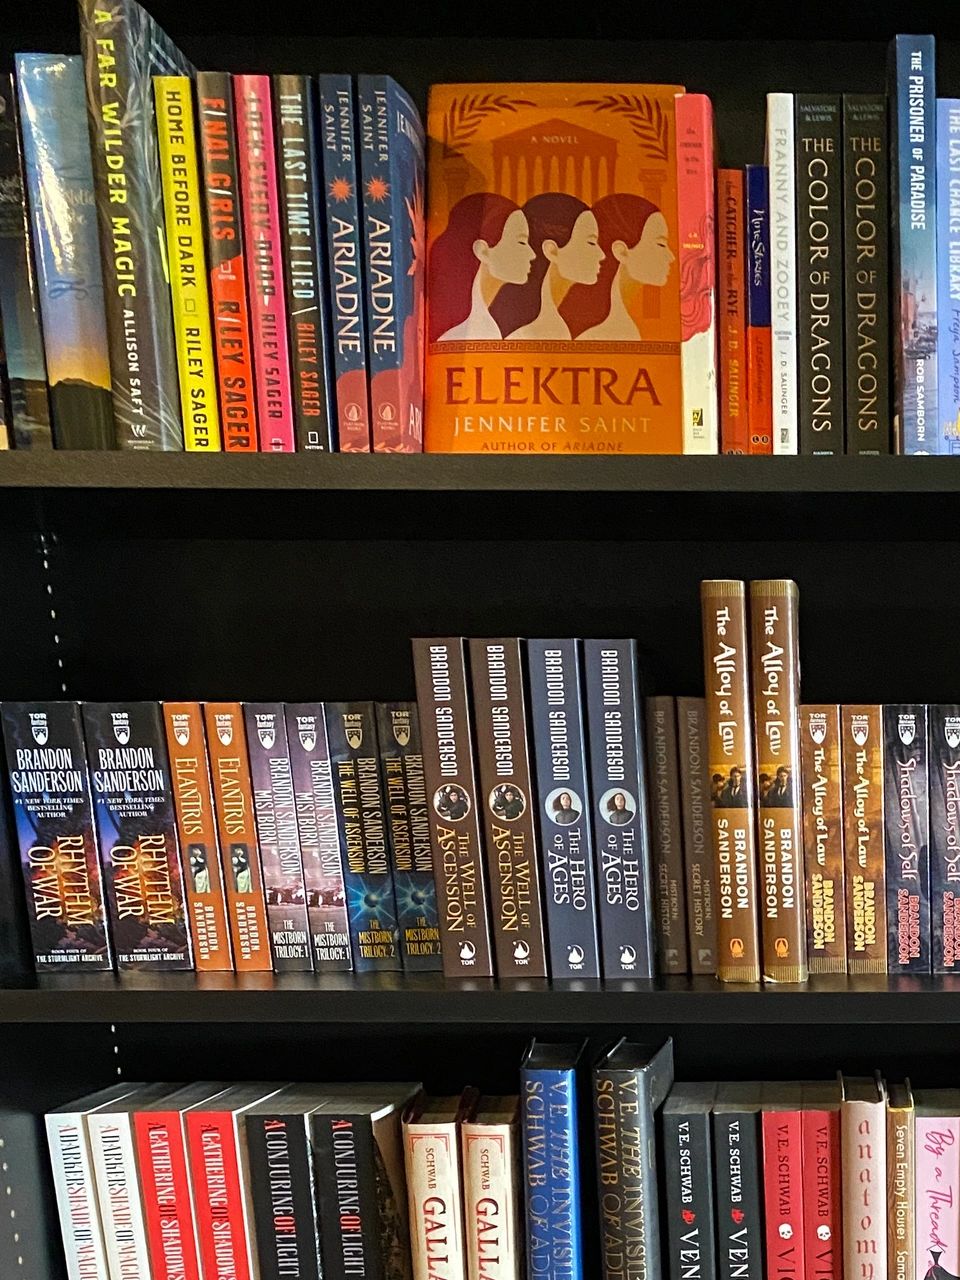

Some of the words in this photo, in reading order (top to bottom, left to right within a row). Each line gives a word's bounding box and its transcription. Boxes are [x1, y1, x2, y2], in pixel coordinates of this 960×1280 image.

[94, 9, 112, 24] A
[96, 39, 118, 88] FAR
[911, 51, 922, 70] THE
[166, 91, 184, 144] HOME
[325, 105, 336, 152] SAINT
[336, 91, 351, 162] JENNIFER
[909, 75, 925, 142] PRISONER
[101, 103, 127, 205] WILDER
[531, 135, 538, 144] A
[543, 136, 578, 144] NOVEL
[802, 138, 834, 153] THE
[912, 148, 922, 161] OF
[172, 154, 190, 226] BEFORE
[808, 158, 828, 264] COLOR
[911, 166, 926, 230] PARADISE
[111, 217, 136, 297] MAGIC
[177, 235, 195, 287] DARK
[810, 271, 831, 285] OF
[332, 216, 361, 353] ARIADNE
[122, 309, 140, 373] ALLISON
[185, 328, 203, 380] RILEY
[810, 293, 831, 431] DRAGONS
[446, 367, 663, 406] ELEKTRA
[915, 359, 924, 382] ROB
[129, 378, 144, 416] SAFT
[191, 389, 209, 447] SAGER
[916, 385, 925, 441] SAMBORN
[454, 417, 567, 435] JENNIFER
[580, 418, 650, 432] SAINT
[481, 441, 538, 451] AUTHOR
[542, 441, 557, 451] OF
[563, 441, 623, 451] ARIADNE
[716, 606, 731, 636] The
[716, 642, 736, 696] Alloy
[720, 700, 733, 715] of
[16, 749, 72, 769] BRANDON
[717, 721, 734, 756] Law
[12, 771, 83, 793] SANDERSON
[898, 758, 918, 829] Shadows
[27, 846, 55, 872] OF
[901, 835, 911, 850] of
[56, 835, 94, 926] RHYTHM
[718, 819, 732, 919] SANDERSON
[734, 829, 749, 910] BRANDON
[899, 852, 917, 880] Self
[30, 873, 62, 920] WAR
[678, 1122, 690, 1145] V.E.
[896, 1125, 907, 1153] Seven
[425, 1148, 437, 1189] SCHWAB
[680, 1148, 692, 1203] SCHWAB
[897, 1158, 908, 1196] Empty
[897, 1201, 907, 1239] Houses
